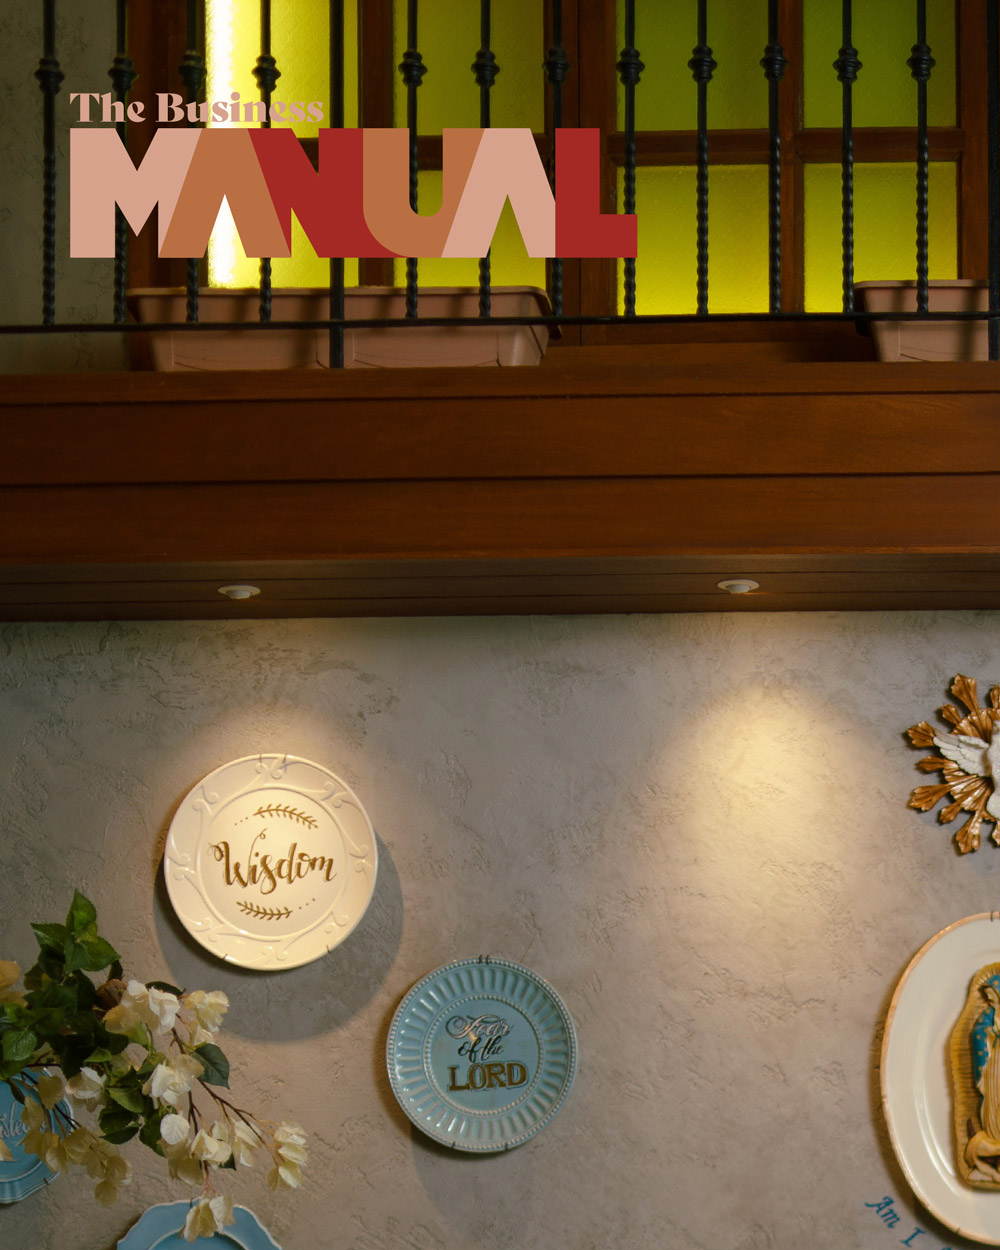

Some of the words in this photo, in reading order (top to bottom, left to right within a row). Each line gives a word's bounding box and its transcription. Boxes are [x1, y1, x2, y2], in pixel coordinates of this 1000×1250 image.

[207, 828, 338, 895] Wisdom
[445, 1014, 514, 1039] Fear
[457, 1037, 482, 1063] of
[480, 1035, 504, 1061] the
[447, 1061, 528, 1092] LORD
[864, 1196, 901, 1229] Am
[900, 1227, 926, 1248] I
